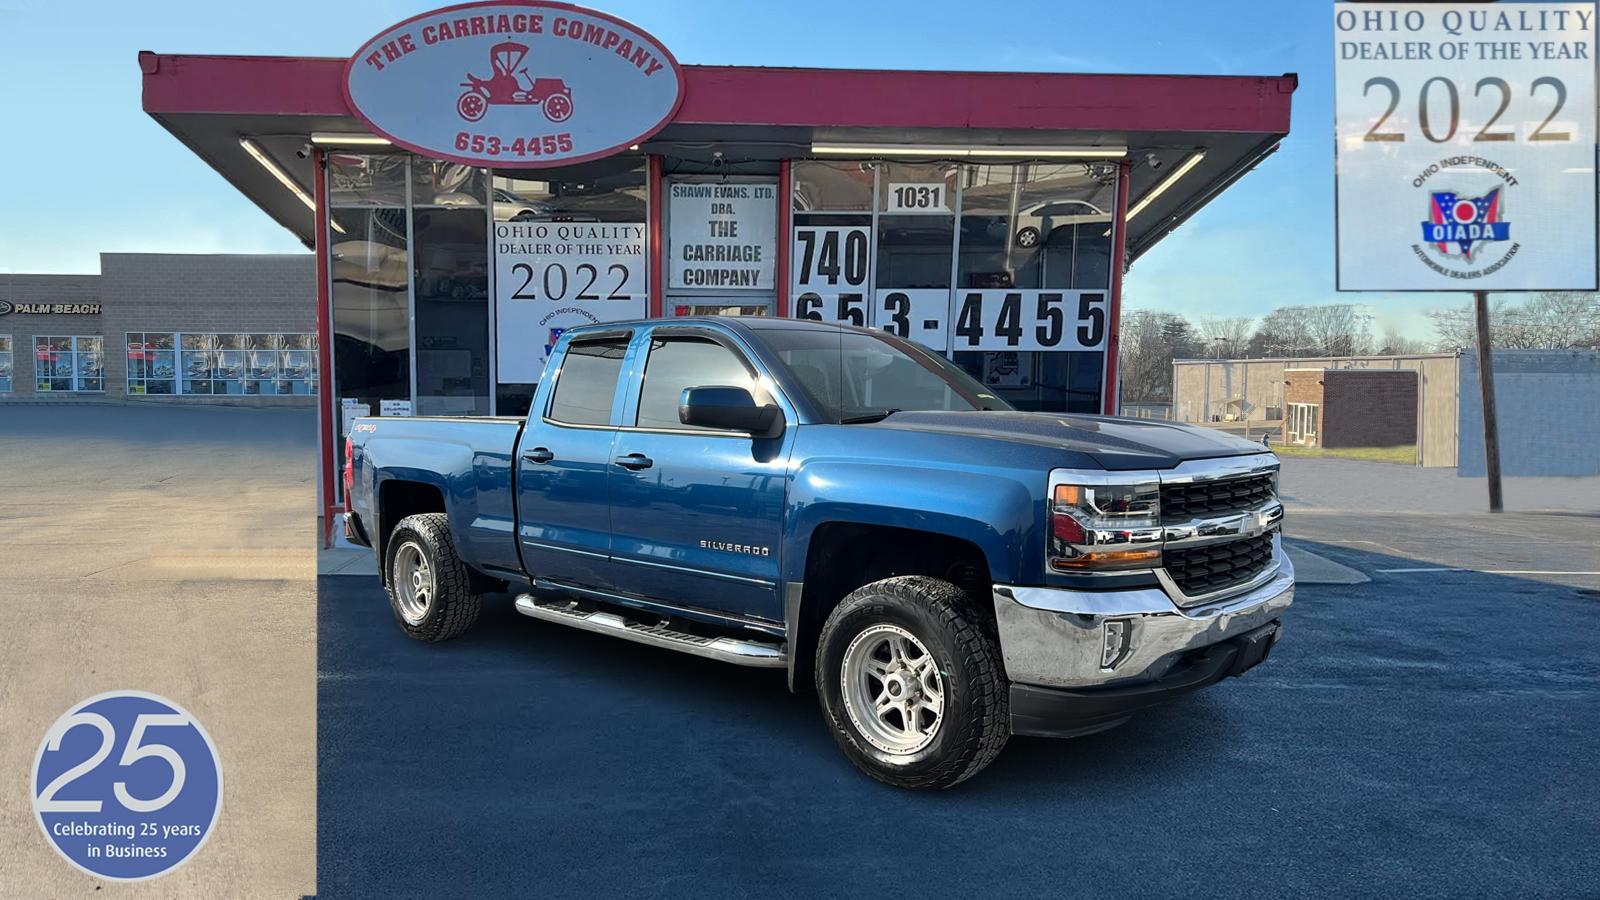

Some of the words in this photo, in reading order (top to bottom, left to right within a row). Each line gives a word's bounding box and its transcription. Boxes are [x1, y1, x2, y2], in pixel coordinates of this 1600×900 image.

[1336, 10, 1425, 32] OHIO
[1442, 10, 1593, 35] QUALITY
[366, 33, 416, 72] THE
[422, 14, 544, 45] CARRIAGE
[553, 17, 664, 77] COMPANY
[1340, 41, 1433, 60] DEALER
[1439, 41, 1469, 60] OF
[1475, 41, 1522, 60] THE
[1528, 41, 1589, 60] YEAR
[1363, 76, 1571, 143] 2022
[455, 132, 574, 157] 653-4455
[1412, 164, 1439, 188] OHIO
[1440, 156, 1519, 187] INDEPENDENT
[673, 186, 712, 198] SHAWN
[894, 186, 940, 208] 1031
[711, 203, 736, 215] DBA.
[497, 226, 548, 238] OHIO
[557, 226, 644, 241] QUALITY
[708, 220, 738, 238] THE
[1432, 224, 1495, 240] OIADA
[499, 243, 552, 255] DEALER
[555, 243, 574, 255] OF
[575, 243, 603, 255] THE
[606, 243, 641, 255] YEAR
[683, 244, 762, 262] CARRIAGE
[797, 229, 868, 287] 740
[511, 262, 632, 301] 2022
[683, 268, 761, 286] COMPANY
[15, 303, 50, 314] PALM
[54, 304, 100, 314] BEACH
[700, 540, 769, 556] SILVERADO
